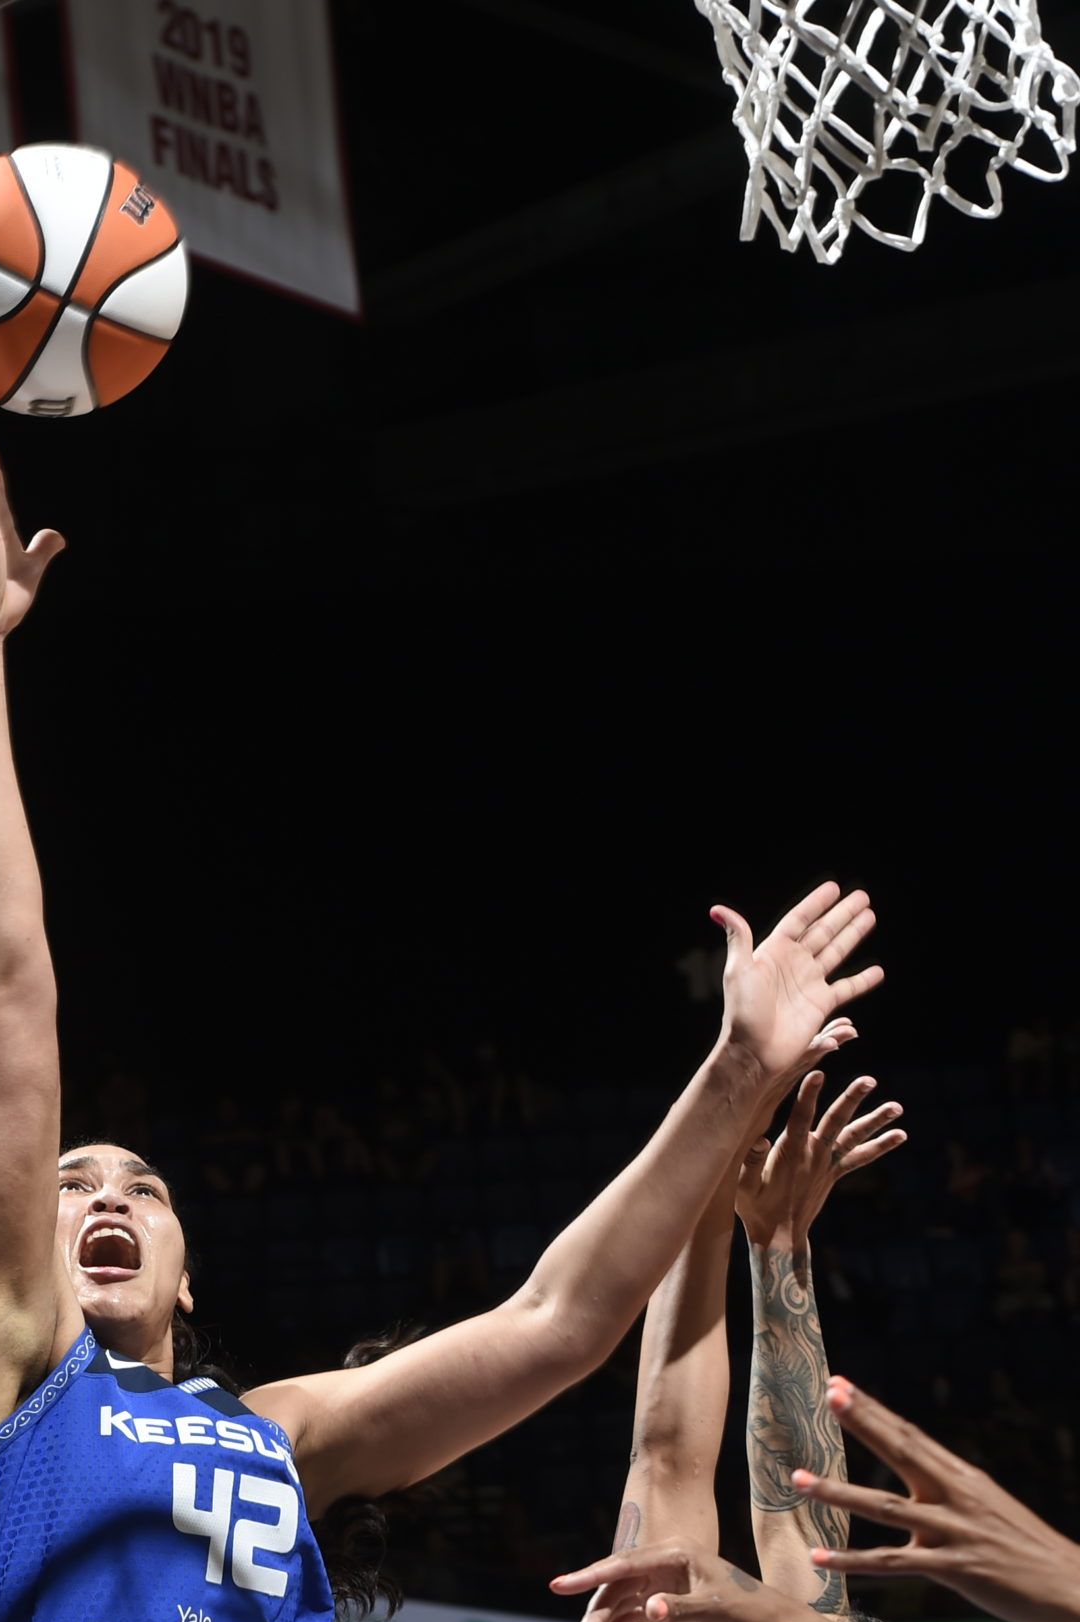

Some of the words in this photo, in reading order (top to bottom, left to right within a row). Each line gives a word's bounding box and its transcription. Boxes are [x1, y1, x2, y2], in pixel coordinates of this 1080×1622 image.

[157, 0, 251, 79] 2019
[152, 52, 267, 148] WNBA
[150, 114, 280, 213] FINALS
[172, 1462, 299, 1598] 42
